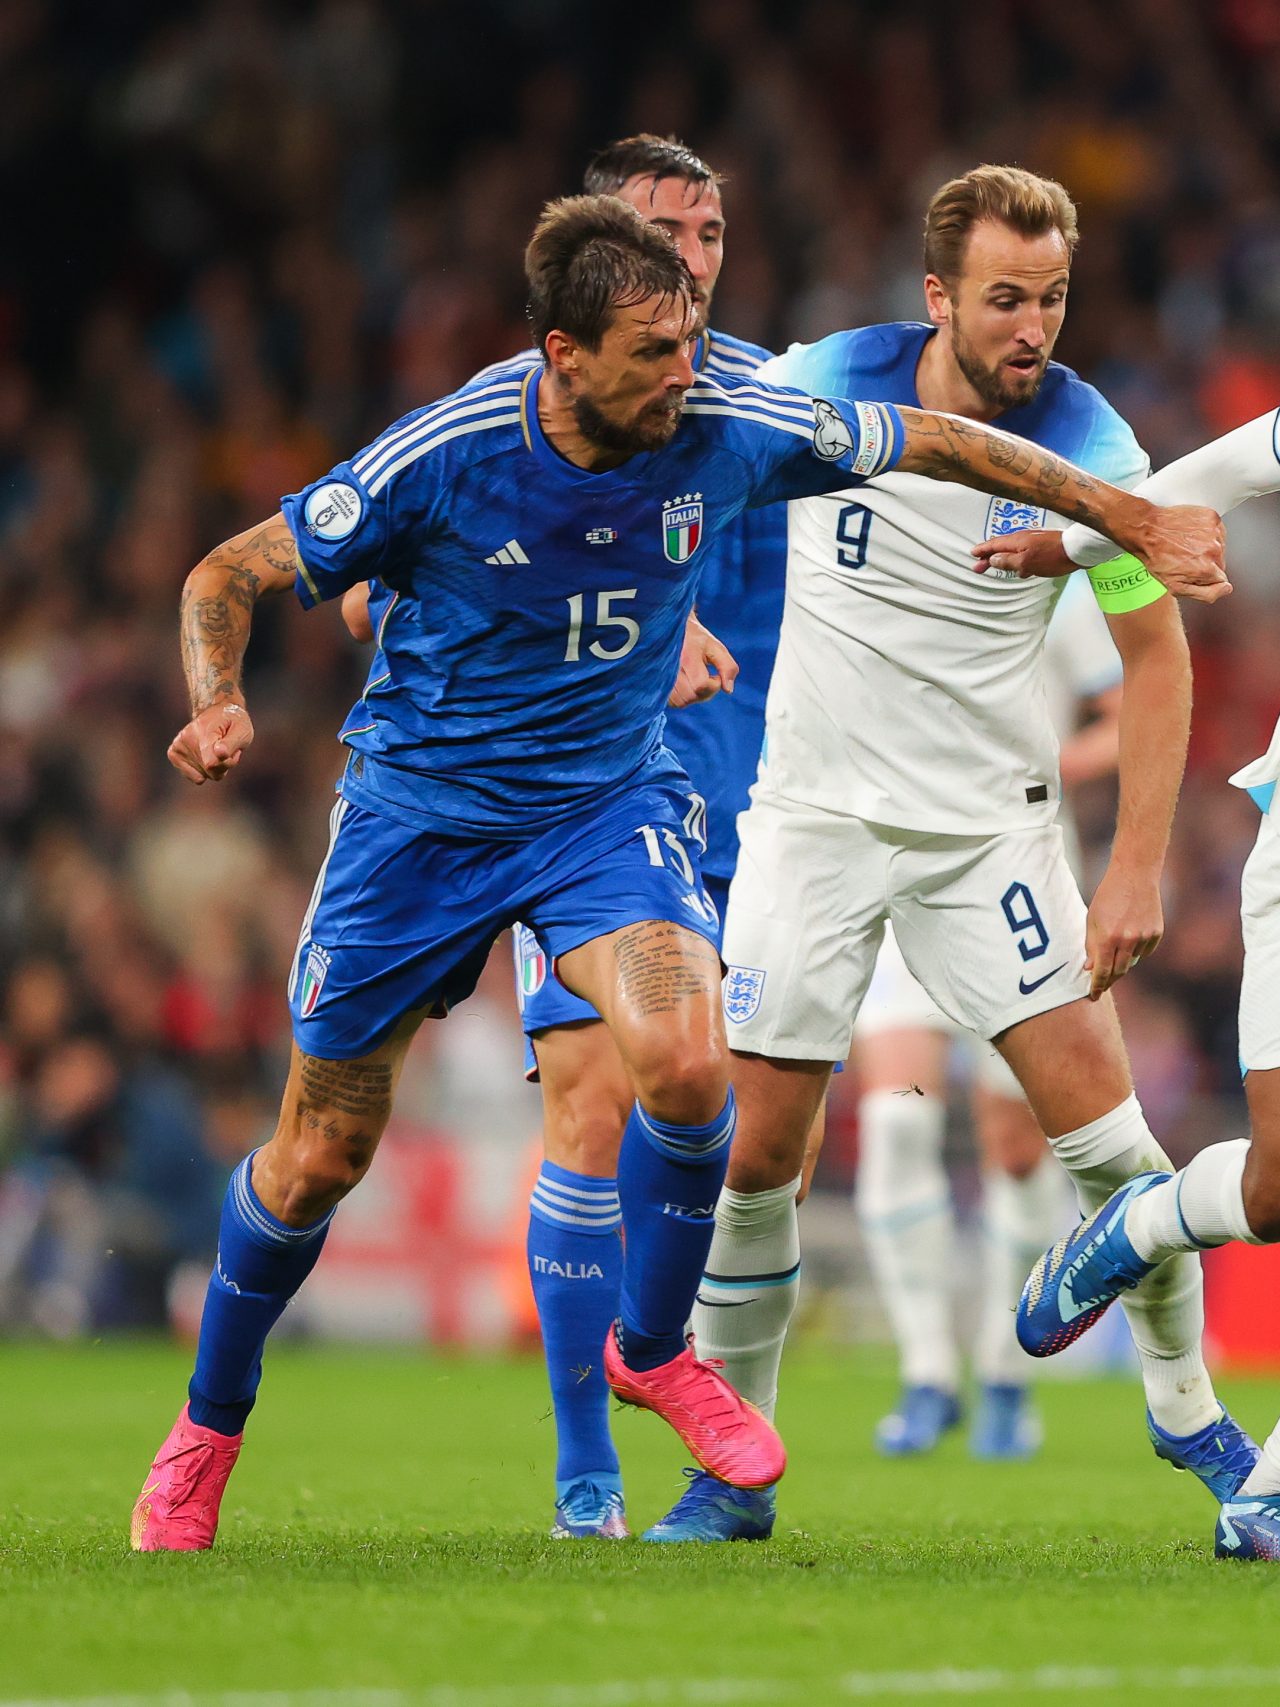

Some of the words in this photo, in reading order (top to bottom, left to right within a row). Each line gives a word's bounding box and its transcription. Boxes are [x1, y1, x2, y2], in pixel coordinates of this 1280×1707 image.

[328, 493, 350, 520] CHAMPIONS
[333, 489, 355, 516] EUROPEAN
[666, 507, 700, 526] ITALIA
[836, 503, 874, 570] 9
[1097, 570, 1149, 592] RESPECT
[564, 588, 640, 662] 15
[1000, 881, 1050, 962] 9
[534, 1255, 604, 1279] ITALIA
